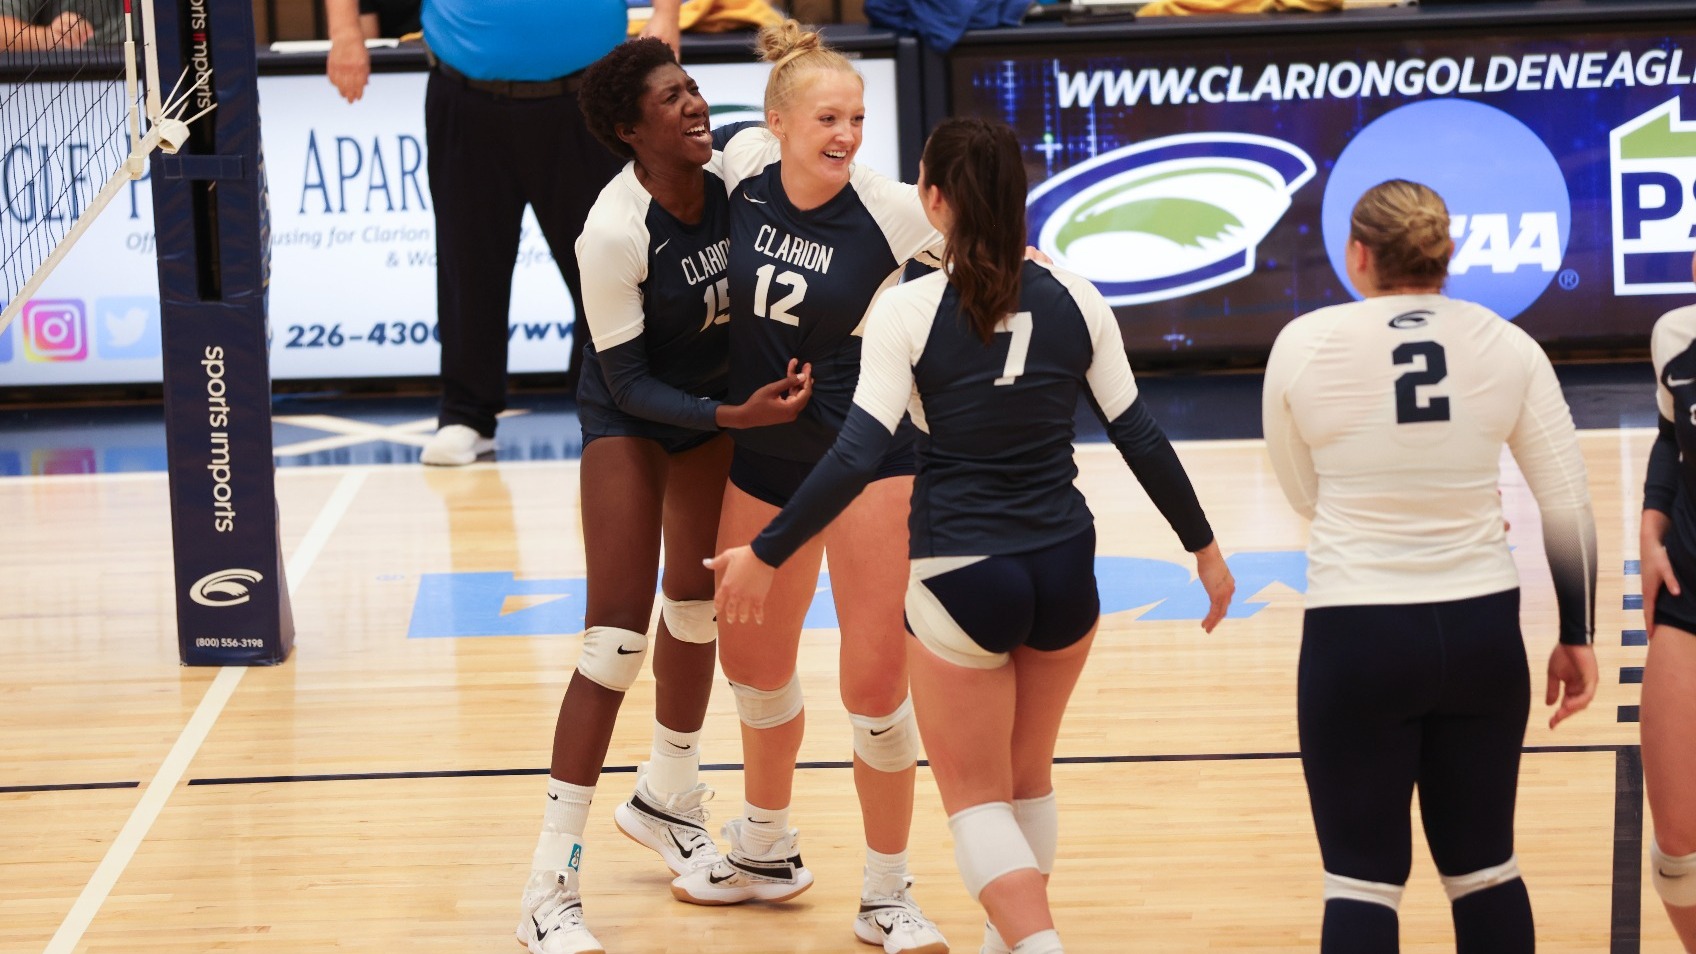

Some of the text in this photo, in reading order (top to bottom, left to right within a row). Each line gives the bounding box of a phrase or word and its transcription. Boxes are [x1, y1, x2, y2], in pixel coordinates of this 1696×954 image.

[1057, 48, 1696, 108] WWW.CLARIONGOLDENEAGL
[327, 226, 355, 249] for
[361, 226, 430, 243] Clarion
[754, 224, 834, 275] CLARION
[753, 263, 808, 327] 12
[993, 311, 1034, 386] 7
[201, 345, 231, 428] sports
[1392, 341, 1450, 425] 2
[195, 638, 264, 648] (800) 556-3198
